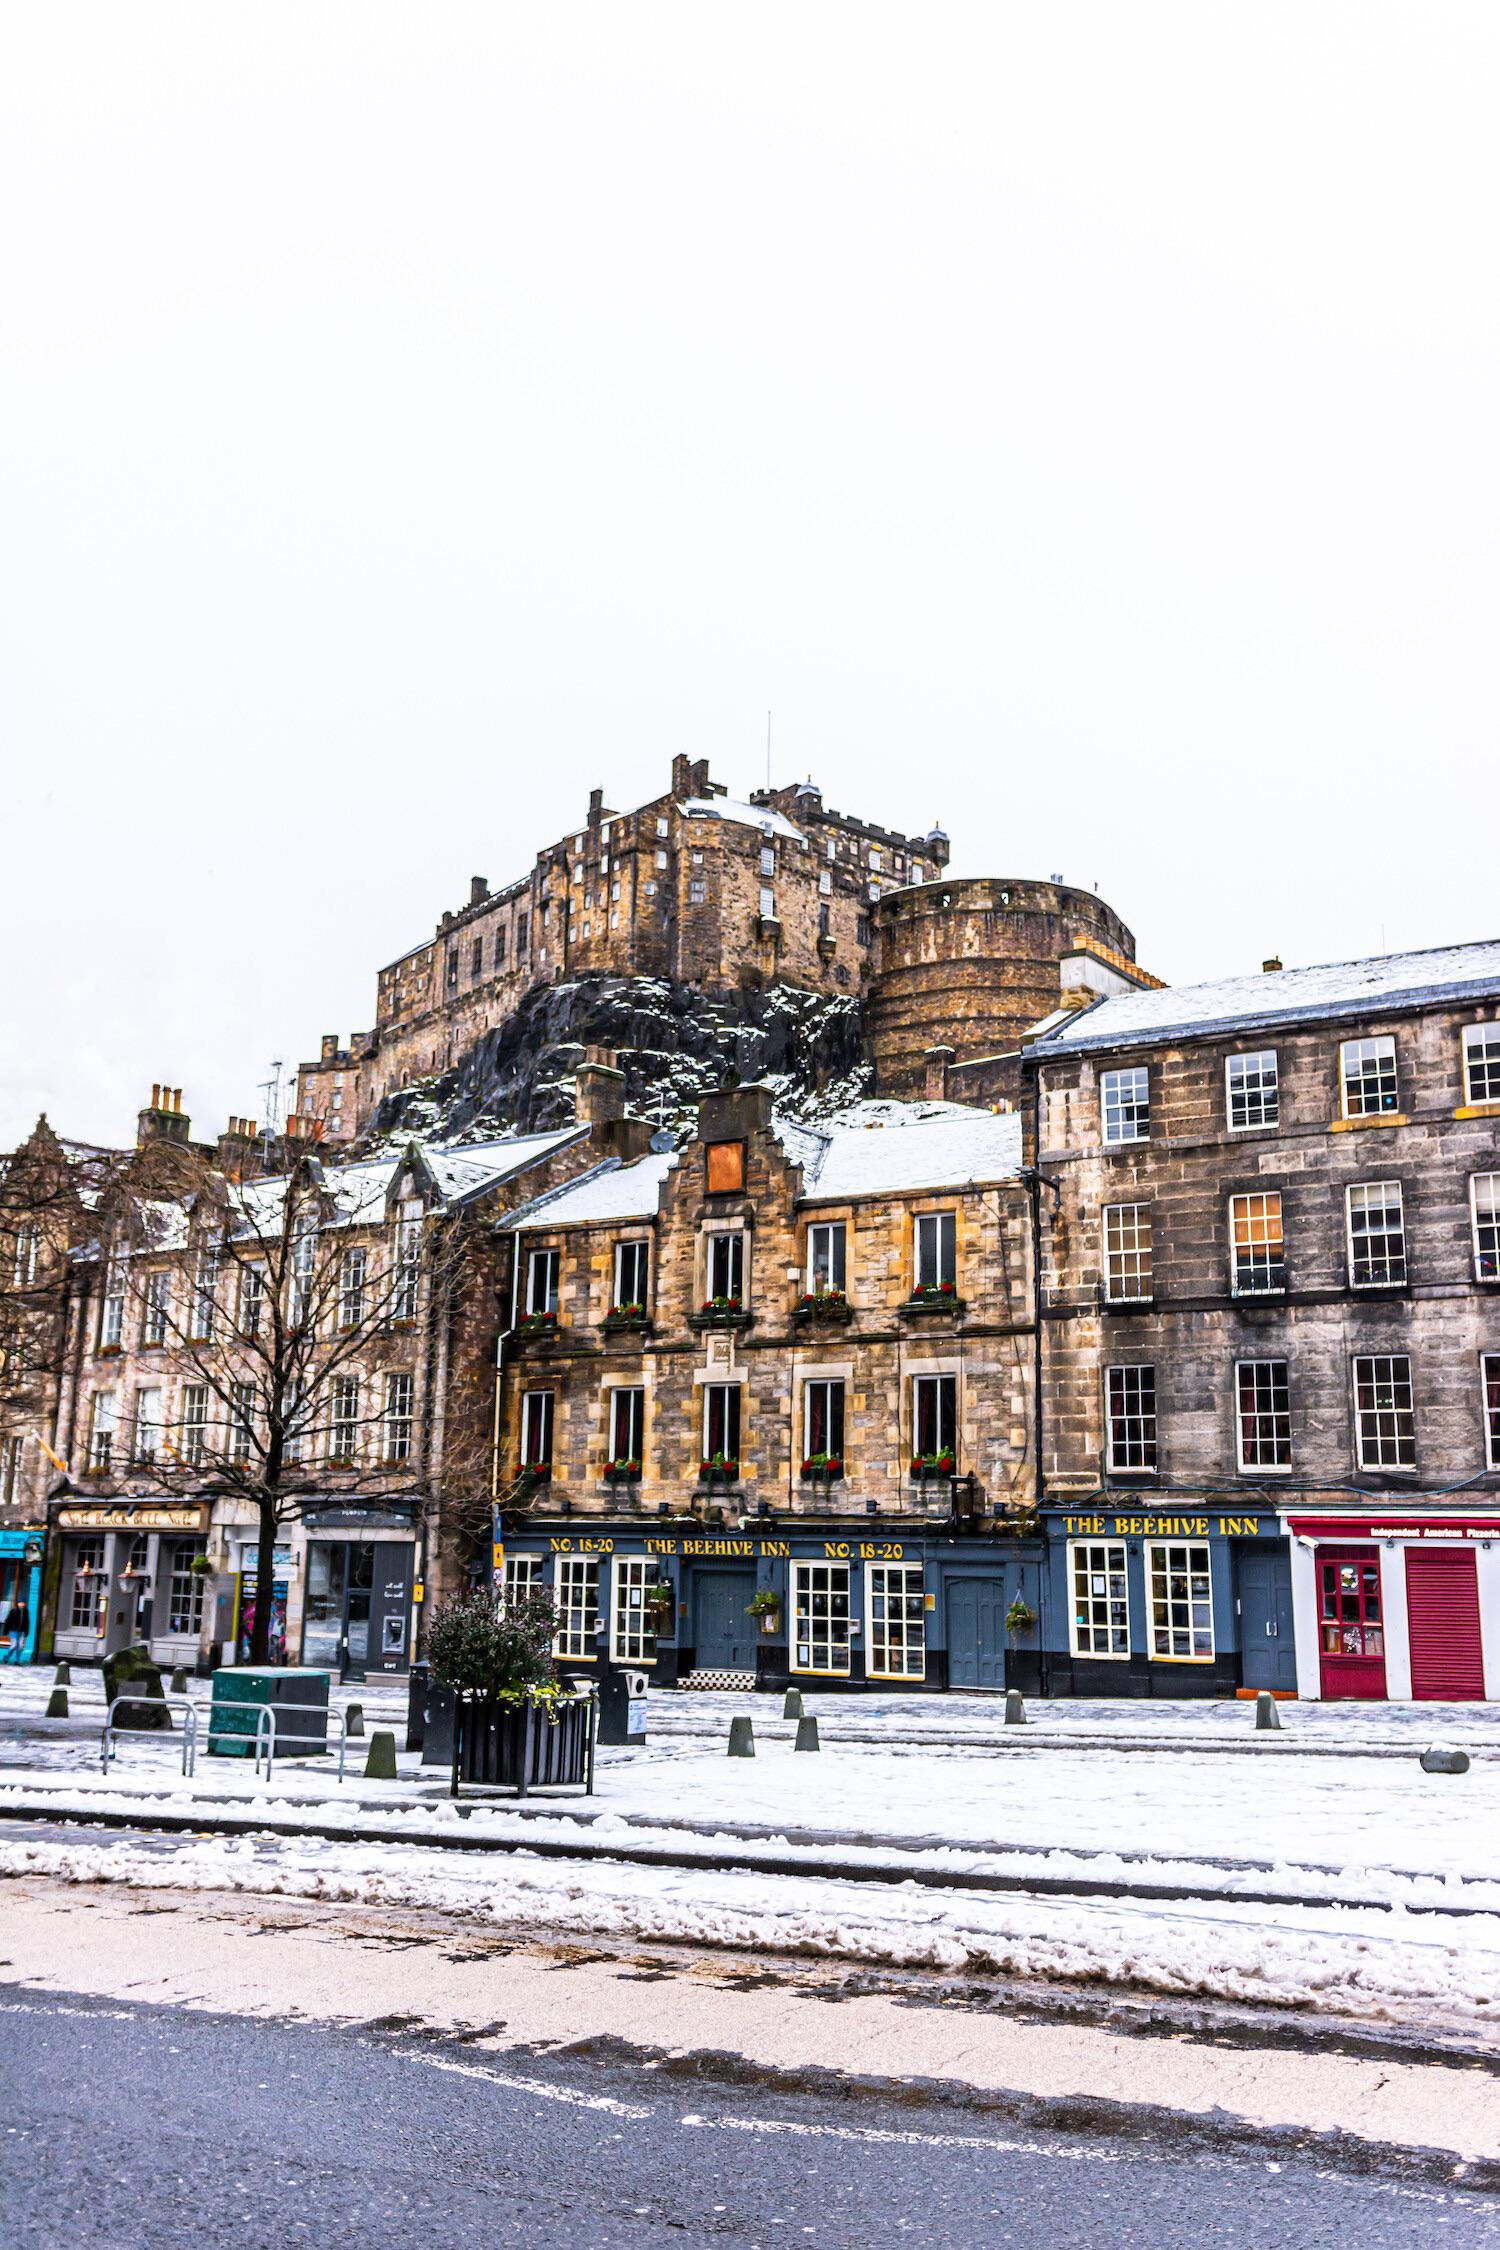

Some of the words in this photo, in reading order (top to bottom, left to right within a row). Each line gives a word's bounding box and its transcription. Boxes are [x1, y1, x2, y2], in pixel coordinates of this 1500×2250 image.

[95, 1511, 129, 1526] BLACK
[133, 1511, 161, 1526] BULL
[1062, 1517, 1106, 1534] THE
[1114, 1517, 1210, 1536] BEEHIVE
[1219, 1518, 1259, 1536] INN
[1370, 1527, 1421, 1538] Independent
[1423, 1528, 1463, 1538] American
[550, 1538, 575, 1552] NO.
[579, 1538, 614, 1553] 18-20
[644, 1539, 677, 1554] THE
[682, 1540, 754, 1556] BEEHIVE
[760, 1541, 790, 1557] INN
[824, 1542, 855, 1558] NO.
[860, 1542, 904, 1559] 18-20
